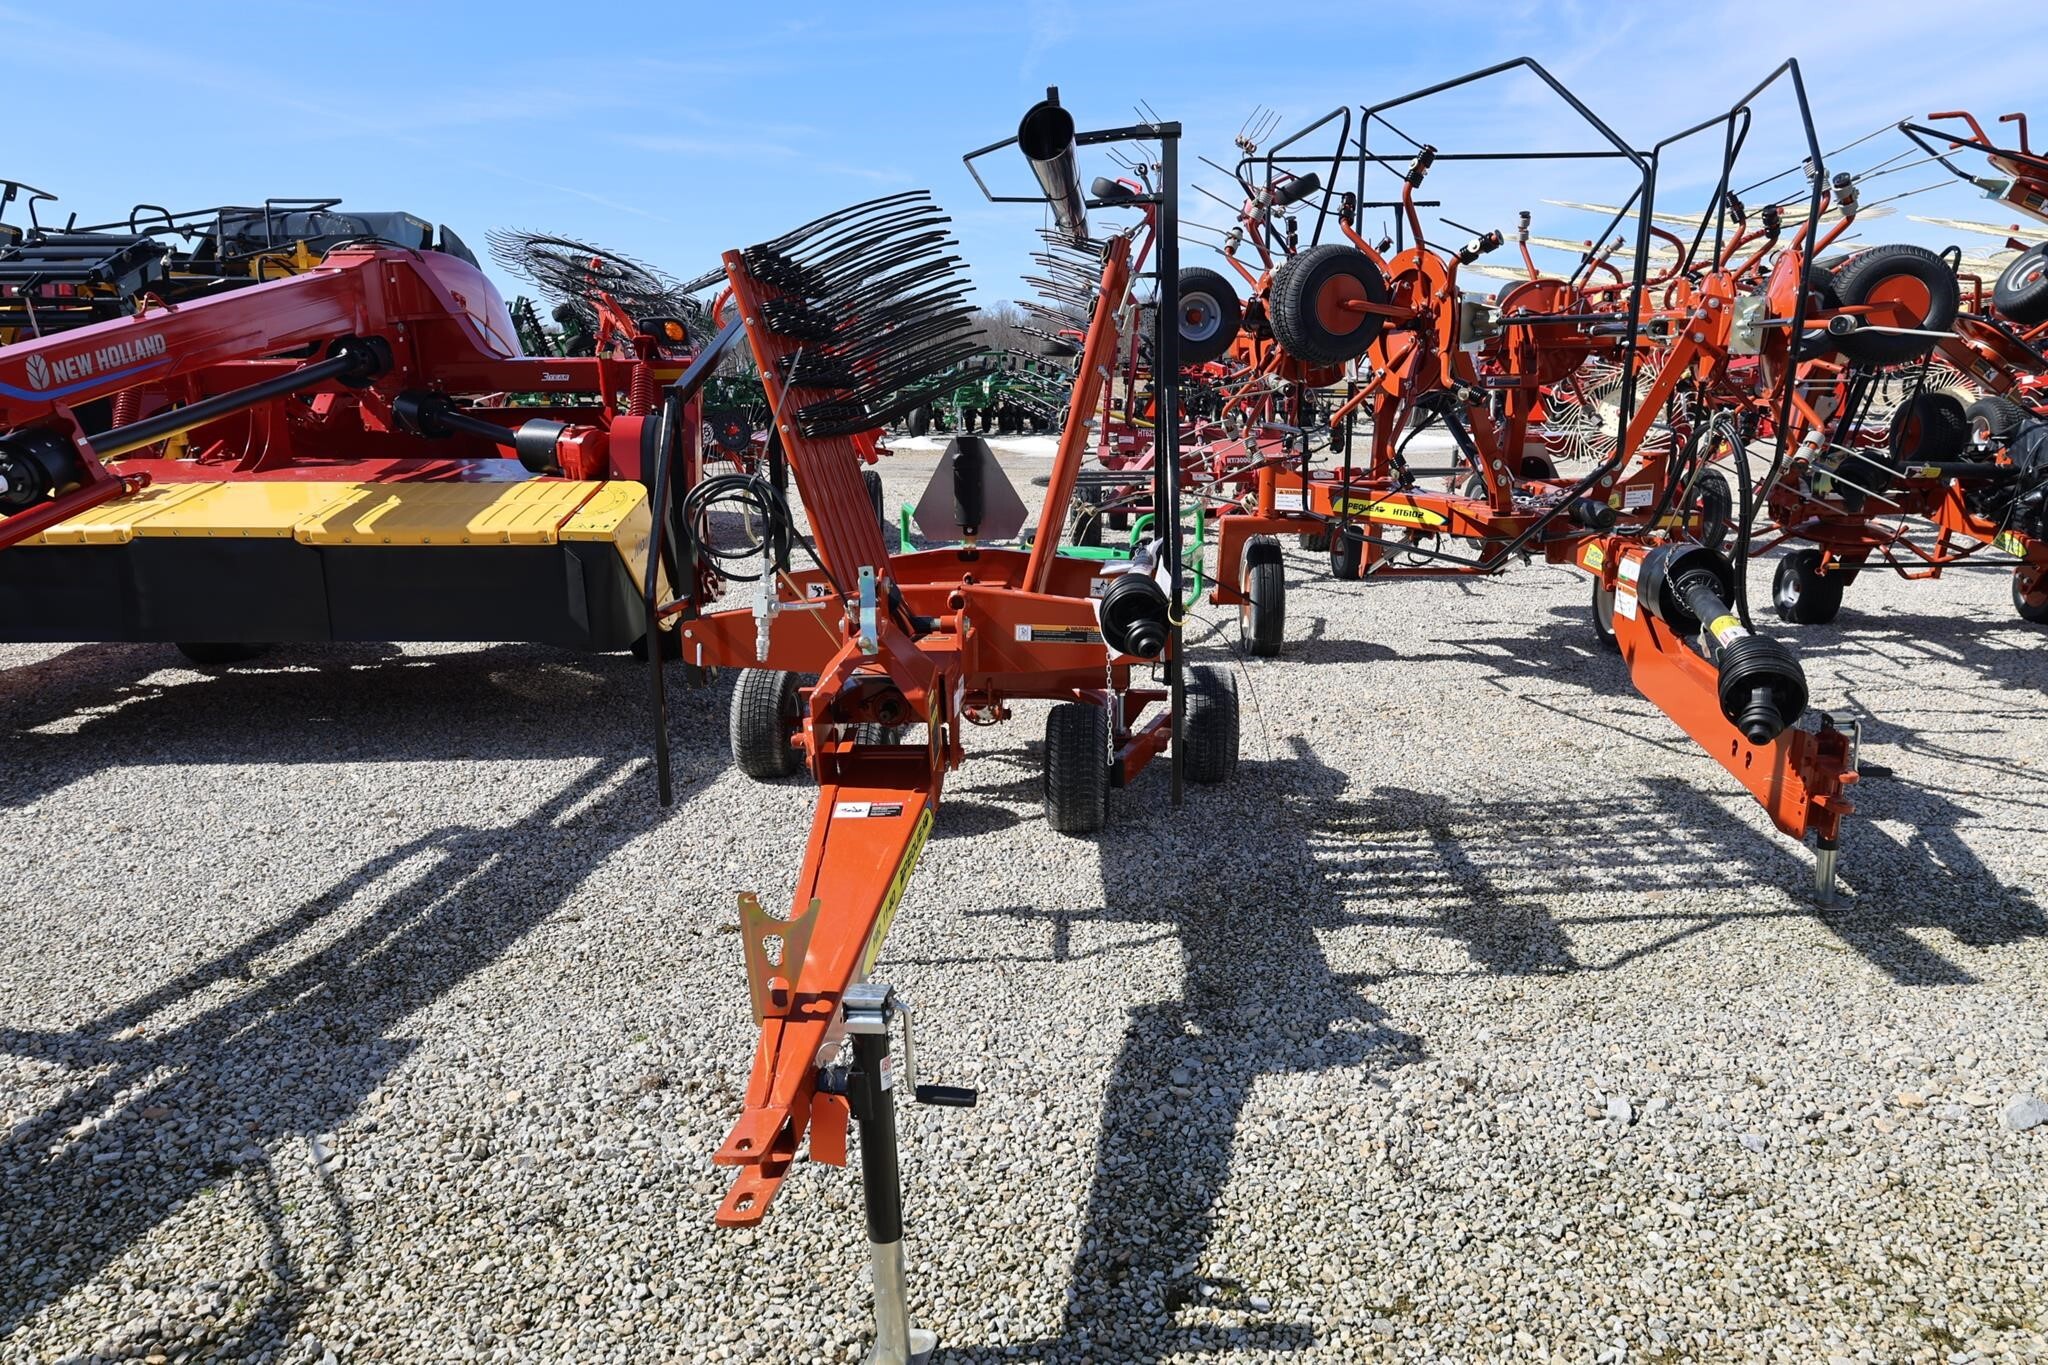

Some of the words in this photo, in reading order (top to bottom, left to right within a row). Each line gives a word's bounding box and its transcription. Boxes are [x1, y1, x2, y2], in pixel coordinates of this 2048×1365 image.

[51, 353, 93, 383] NEW
[95, 334, 167, 371] HOLLAND
[1393, 508, 1424, 519] HT6102
